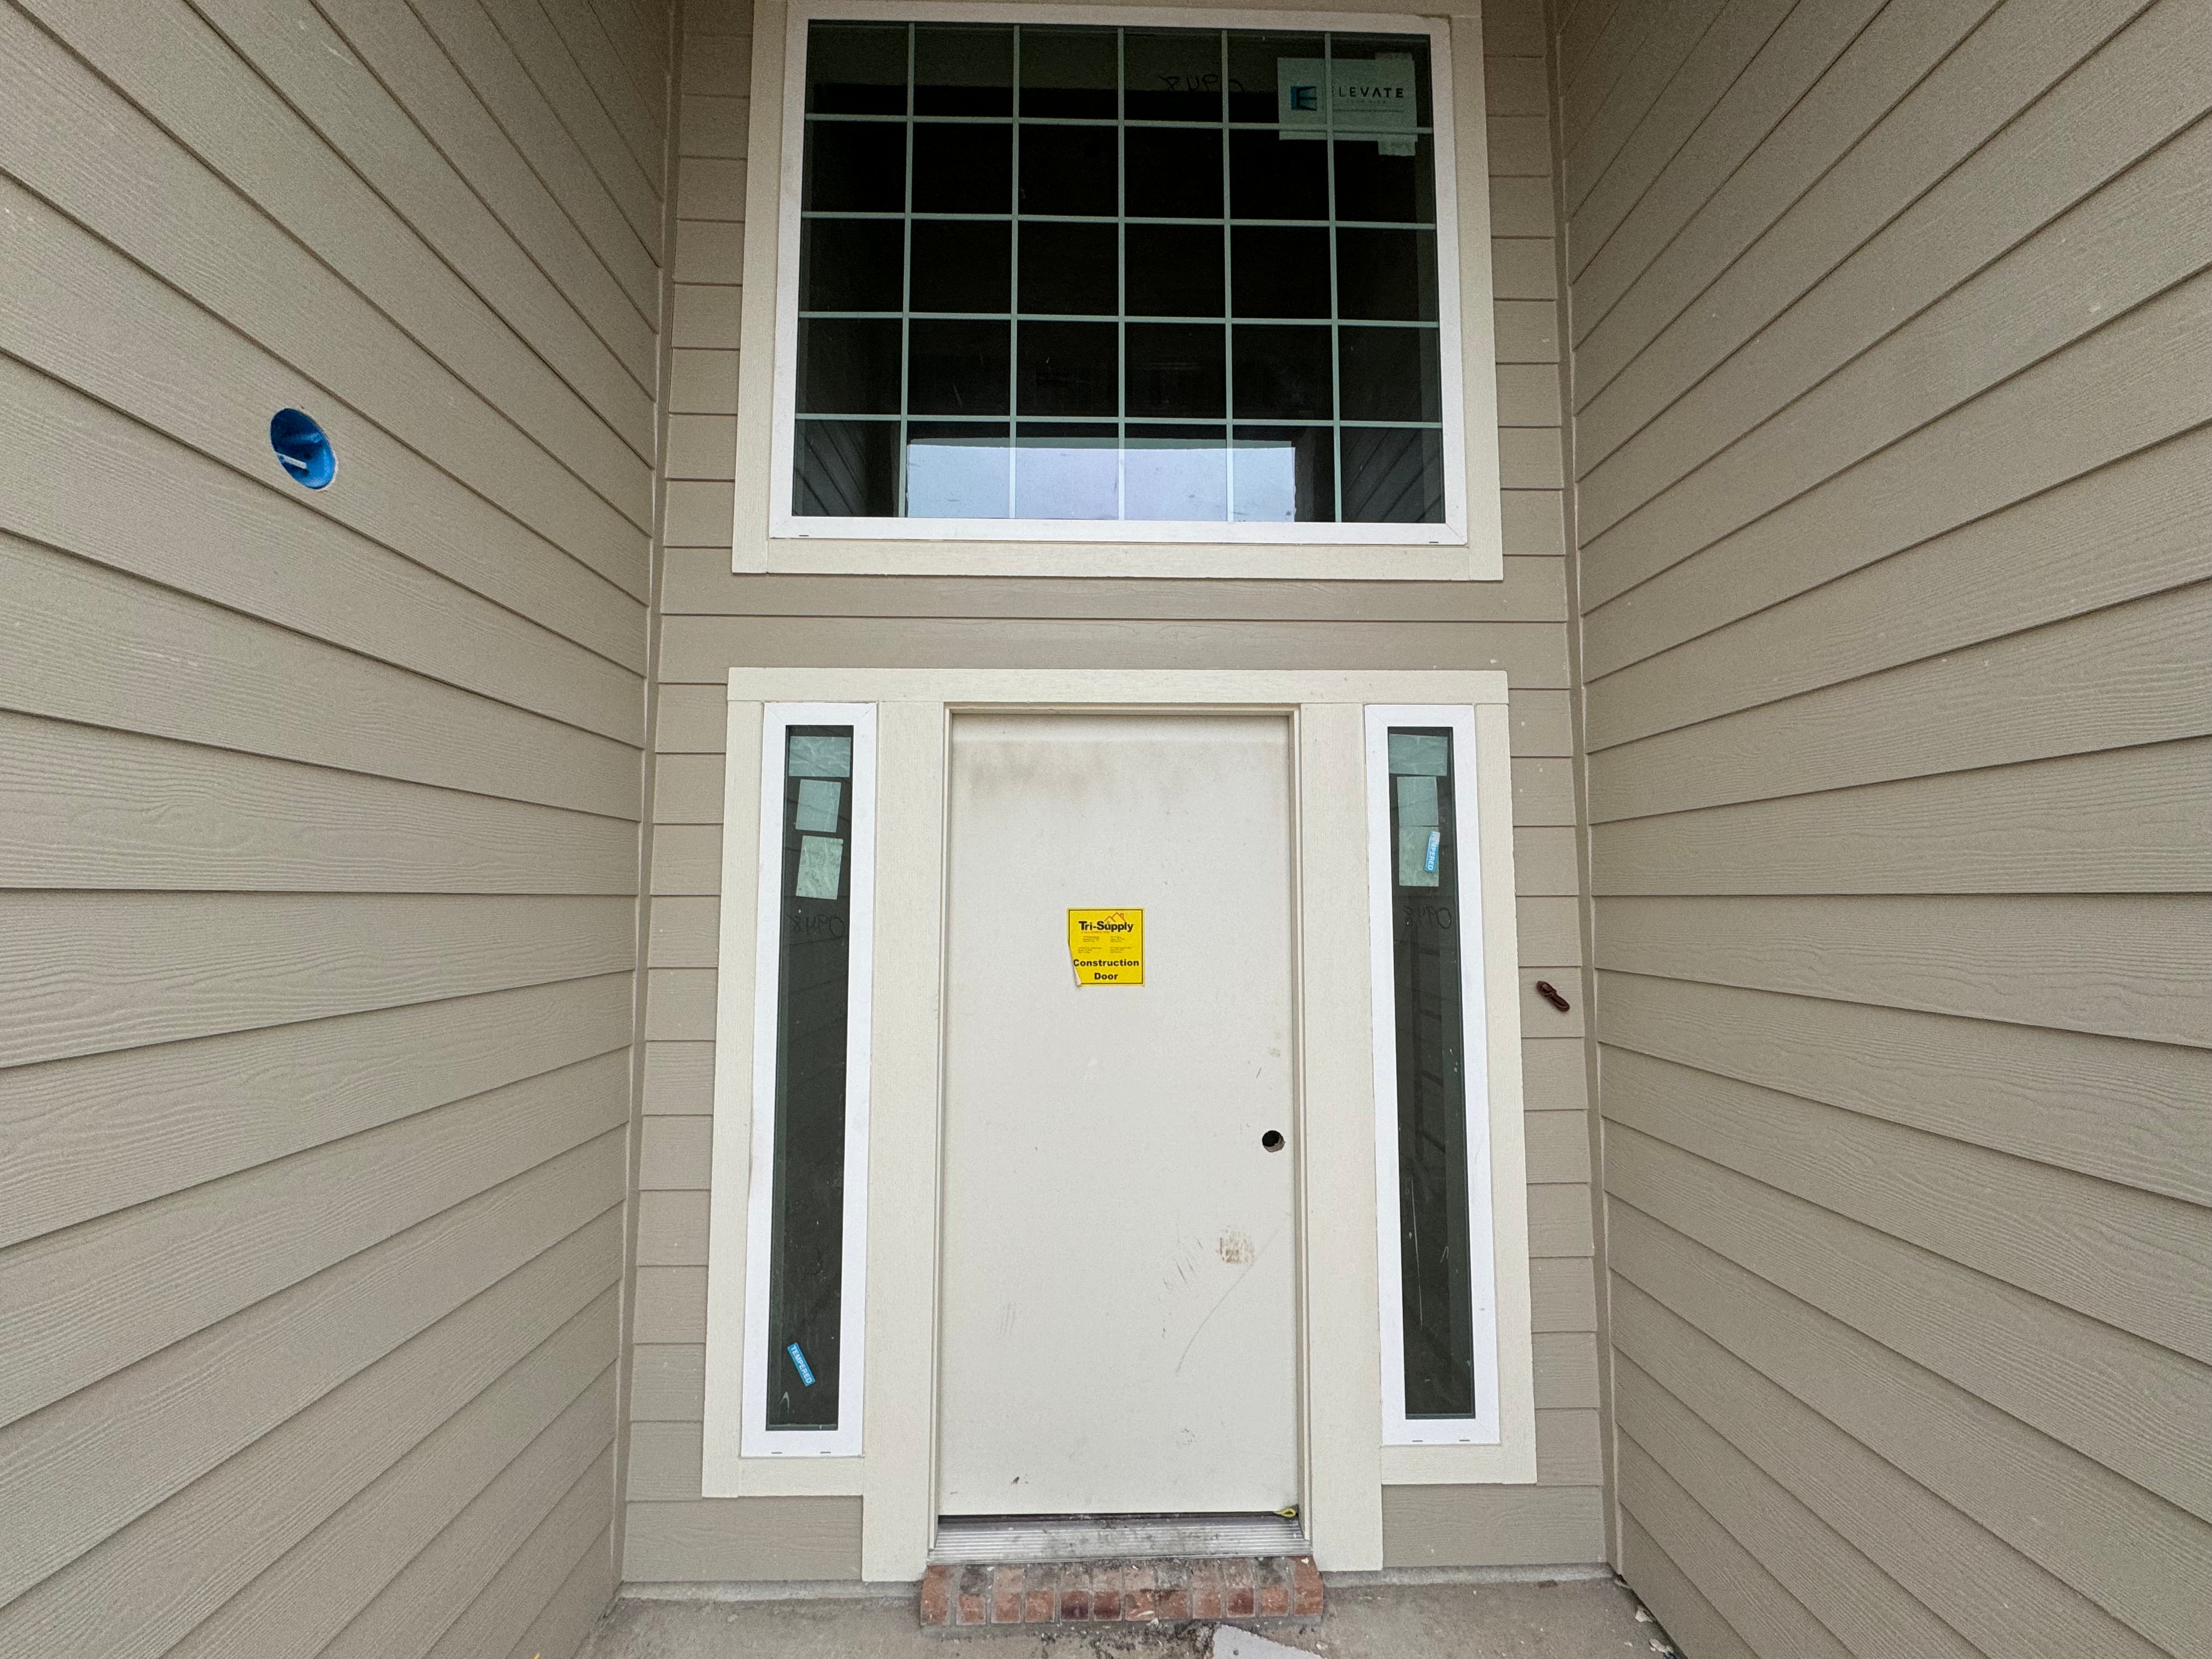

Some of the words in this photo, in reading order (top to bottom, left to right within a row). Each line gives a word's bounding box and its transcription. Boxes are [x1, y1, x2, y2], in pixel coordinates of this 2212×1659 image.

[1332, 86, 1403, 99] LEVATE
[1078, 921, 1133, 932] Tri-Supply
[791, 1345, 812, 1384] TEMPERED
